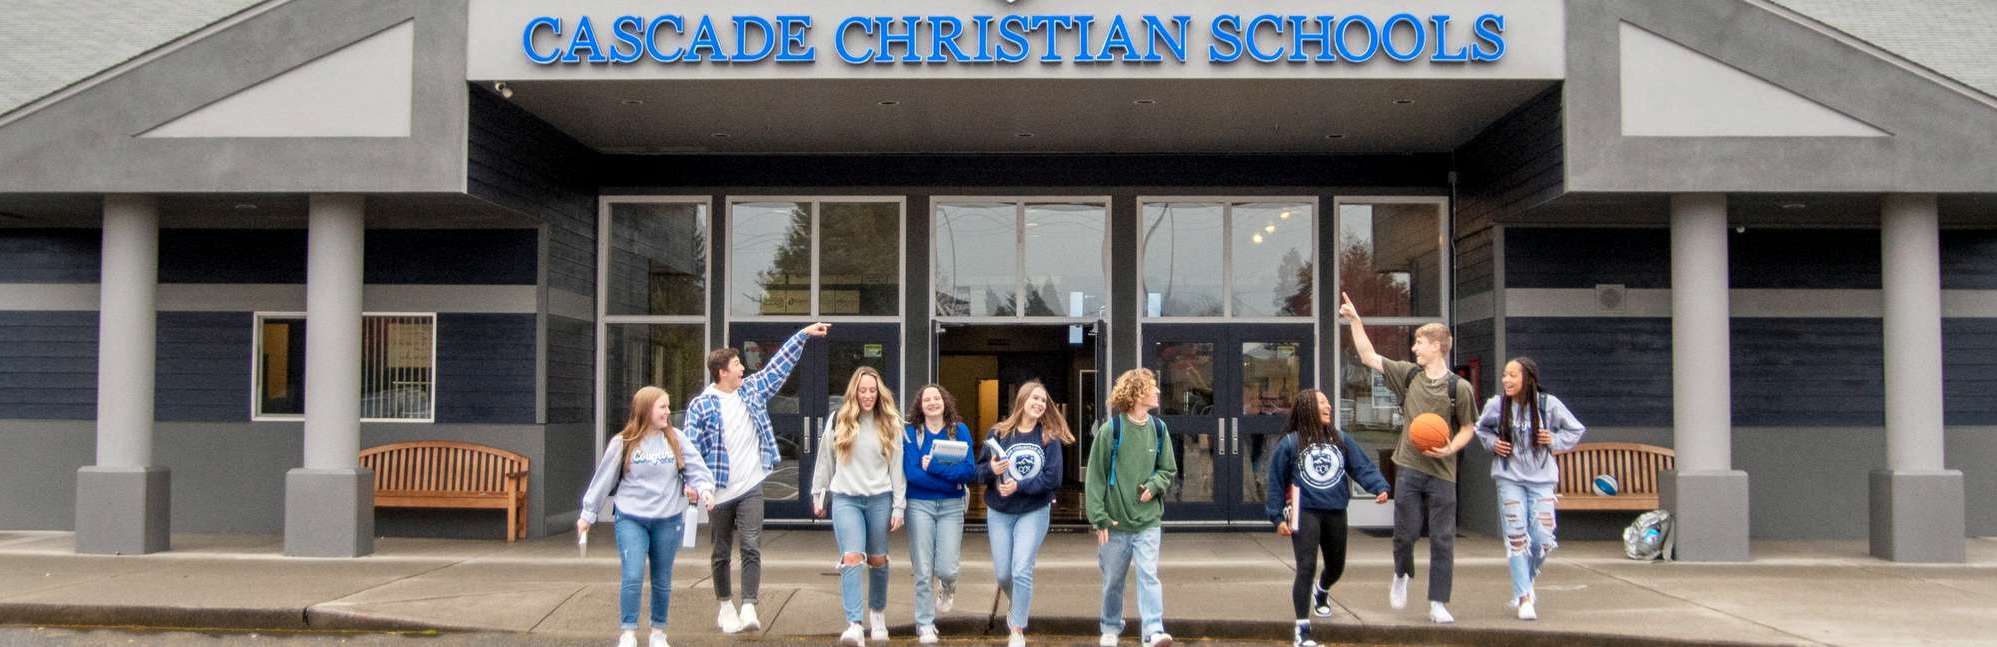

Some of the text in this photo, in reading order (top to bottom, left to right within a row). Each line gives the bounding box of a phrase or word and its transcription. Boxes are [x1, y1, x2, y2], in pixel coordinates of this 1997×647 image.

[523, 13, 1506, 63] CASCADE CHRISTIAN SCHOOLS
